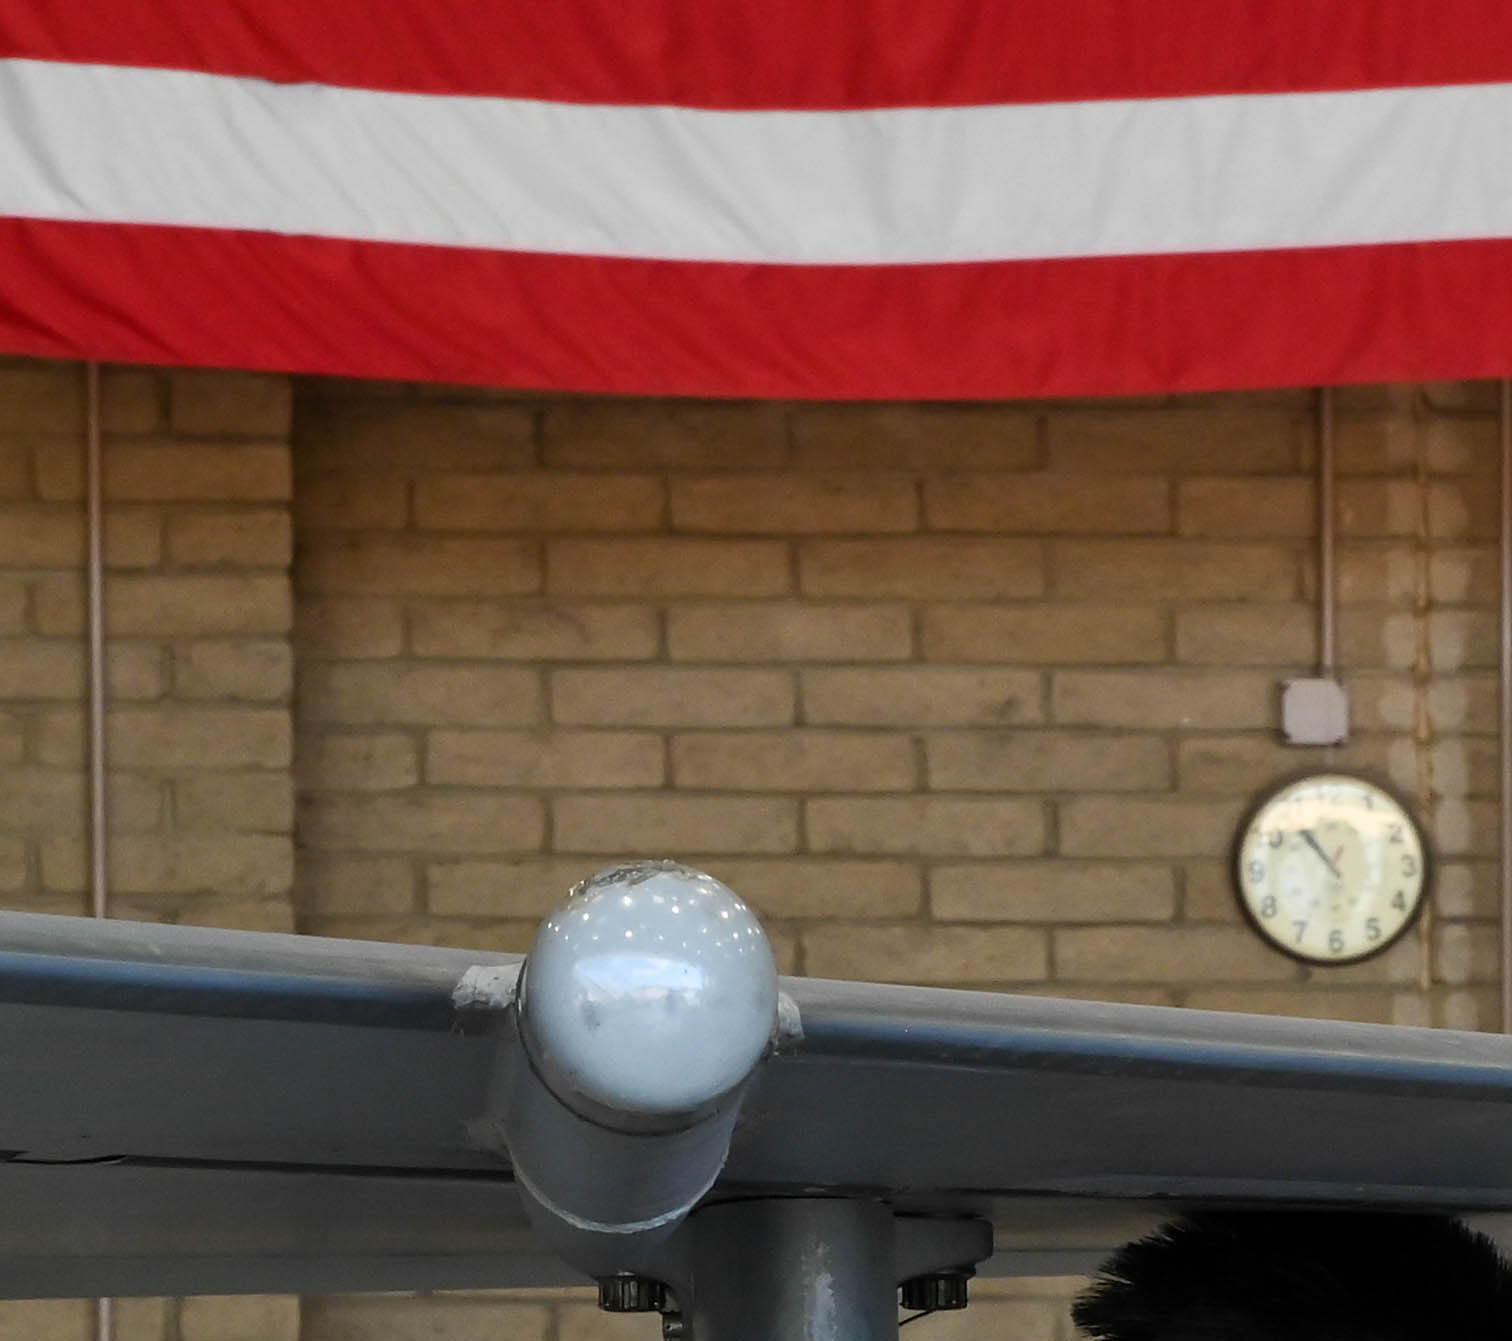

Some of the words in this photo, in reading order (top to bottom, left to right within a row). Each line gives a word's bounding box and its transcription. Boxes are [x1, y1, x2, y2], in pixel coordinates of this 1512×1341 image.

[1388, 823, 1404, 844] 2
[1249, 859, 1265, 884] 9
[1401, 853, 1418, 879] 3
[1261, 895, 1278, 918] 8
[1391, 889, 1407, 912] 4
[1292, 920, 1309, 943] 7
[1365, 917, 1382, 941] 5
[1328, 929, 1345, 953] 6
